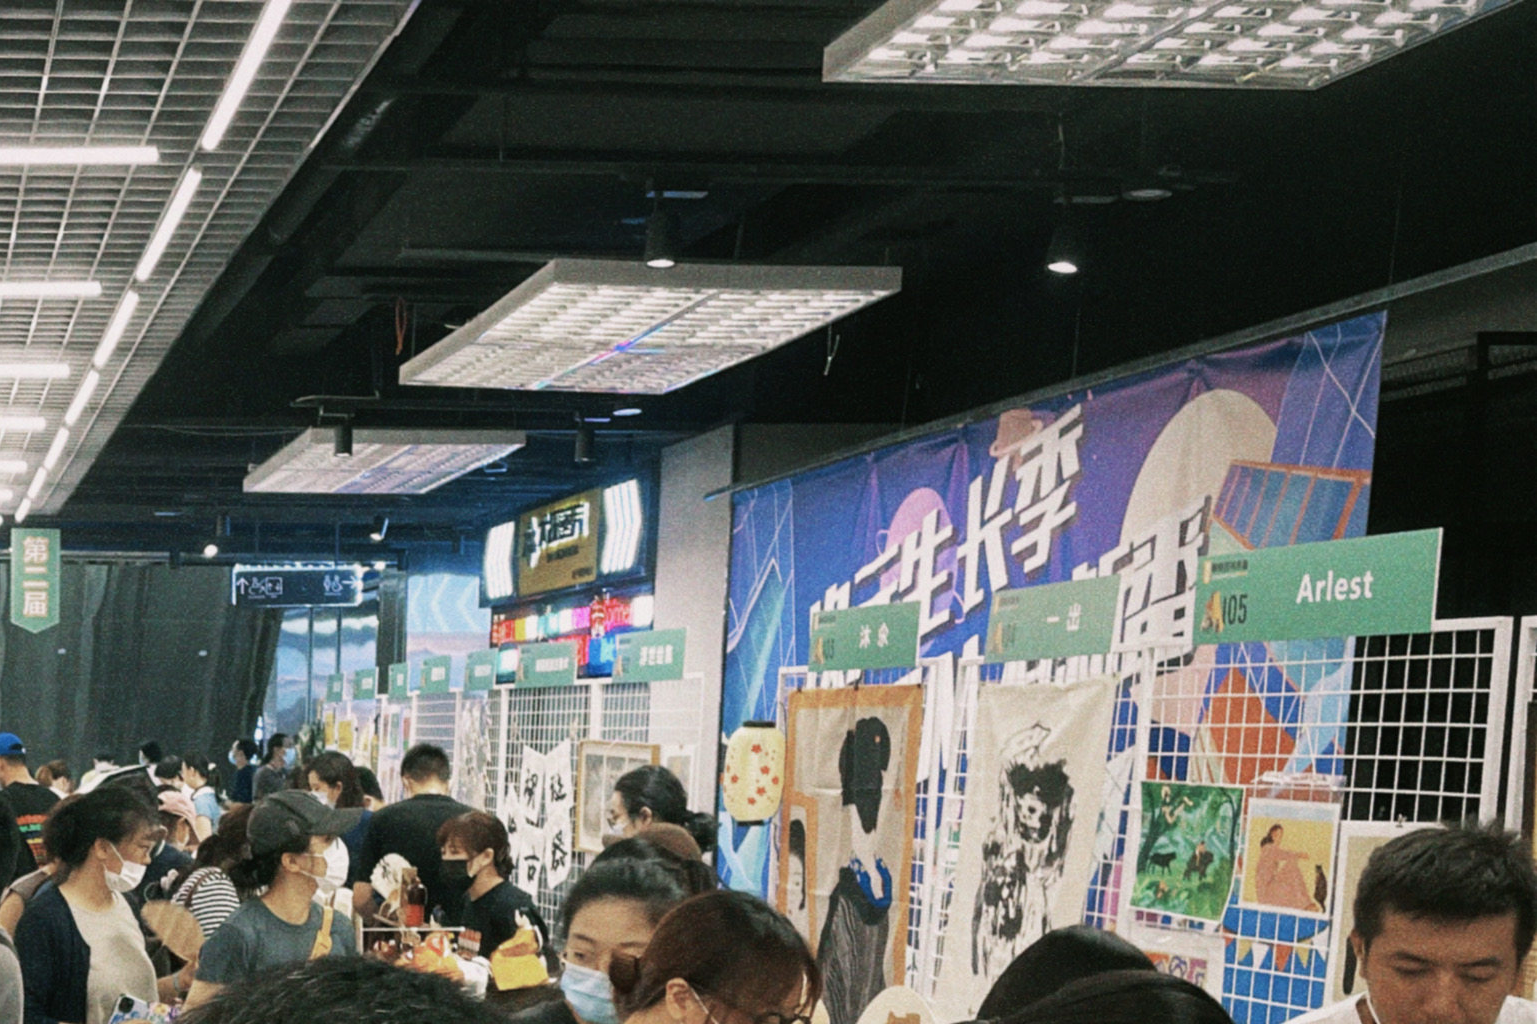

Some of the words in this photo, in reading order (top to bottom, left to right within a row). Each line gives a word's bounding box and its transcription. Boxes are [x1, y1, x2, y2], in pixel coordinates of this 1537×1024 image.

[22, 535, 49, 617] 第二届
[1296, 569, 1375, 604] Arlest
